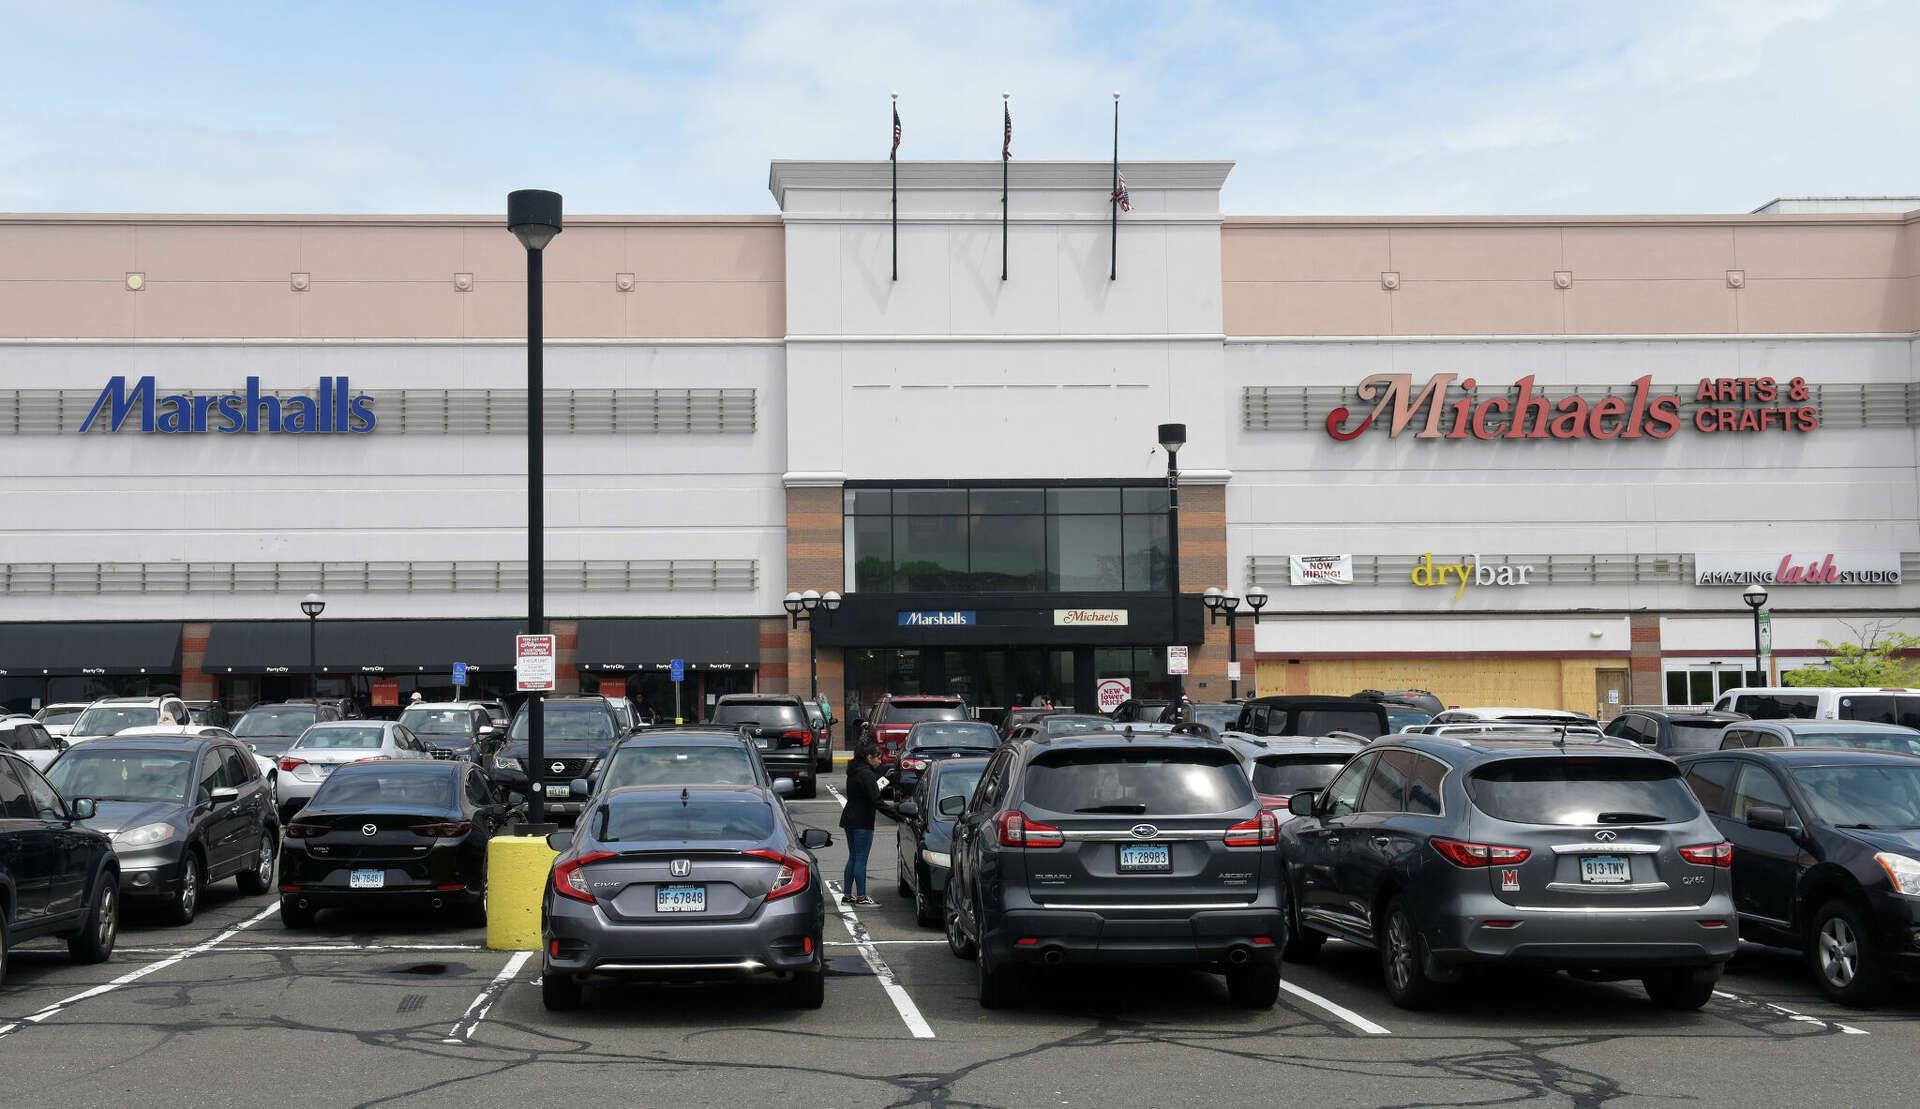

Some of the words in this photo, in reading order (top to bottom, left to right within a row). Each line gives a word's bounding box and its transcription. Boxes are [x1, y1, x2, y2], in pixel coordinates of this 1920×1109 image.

[1698, 377, 1779, 402] ARTS
[1789, 377, 1810, 401] &
[78, 376, 378, 433] Marshalls
[1326, 373, 1682, 441] Michaels
[1694, 406, 1819, 432] CRAFTS
[1302, 570, 1341, 578] HIRING!
[1309, 562, 1333, 570] NOW
[1411, 552, 1534, 599] drybar
[1701, 571, 1774, 583] AMAZING
[1776, 553, 1841, 584] lash
[1841, 571, 1899, 583] STUDIO
[906, 611, 967, 625] Marshalls
[1063, 610, 1119, 624] Michaels
[1503, 870, 1518, 885] M
